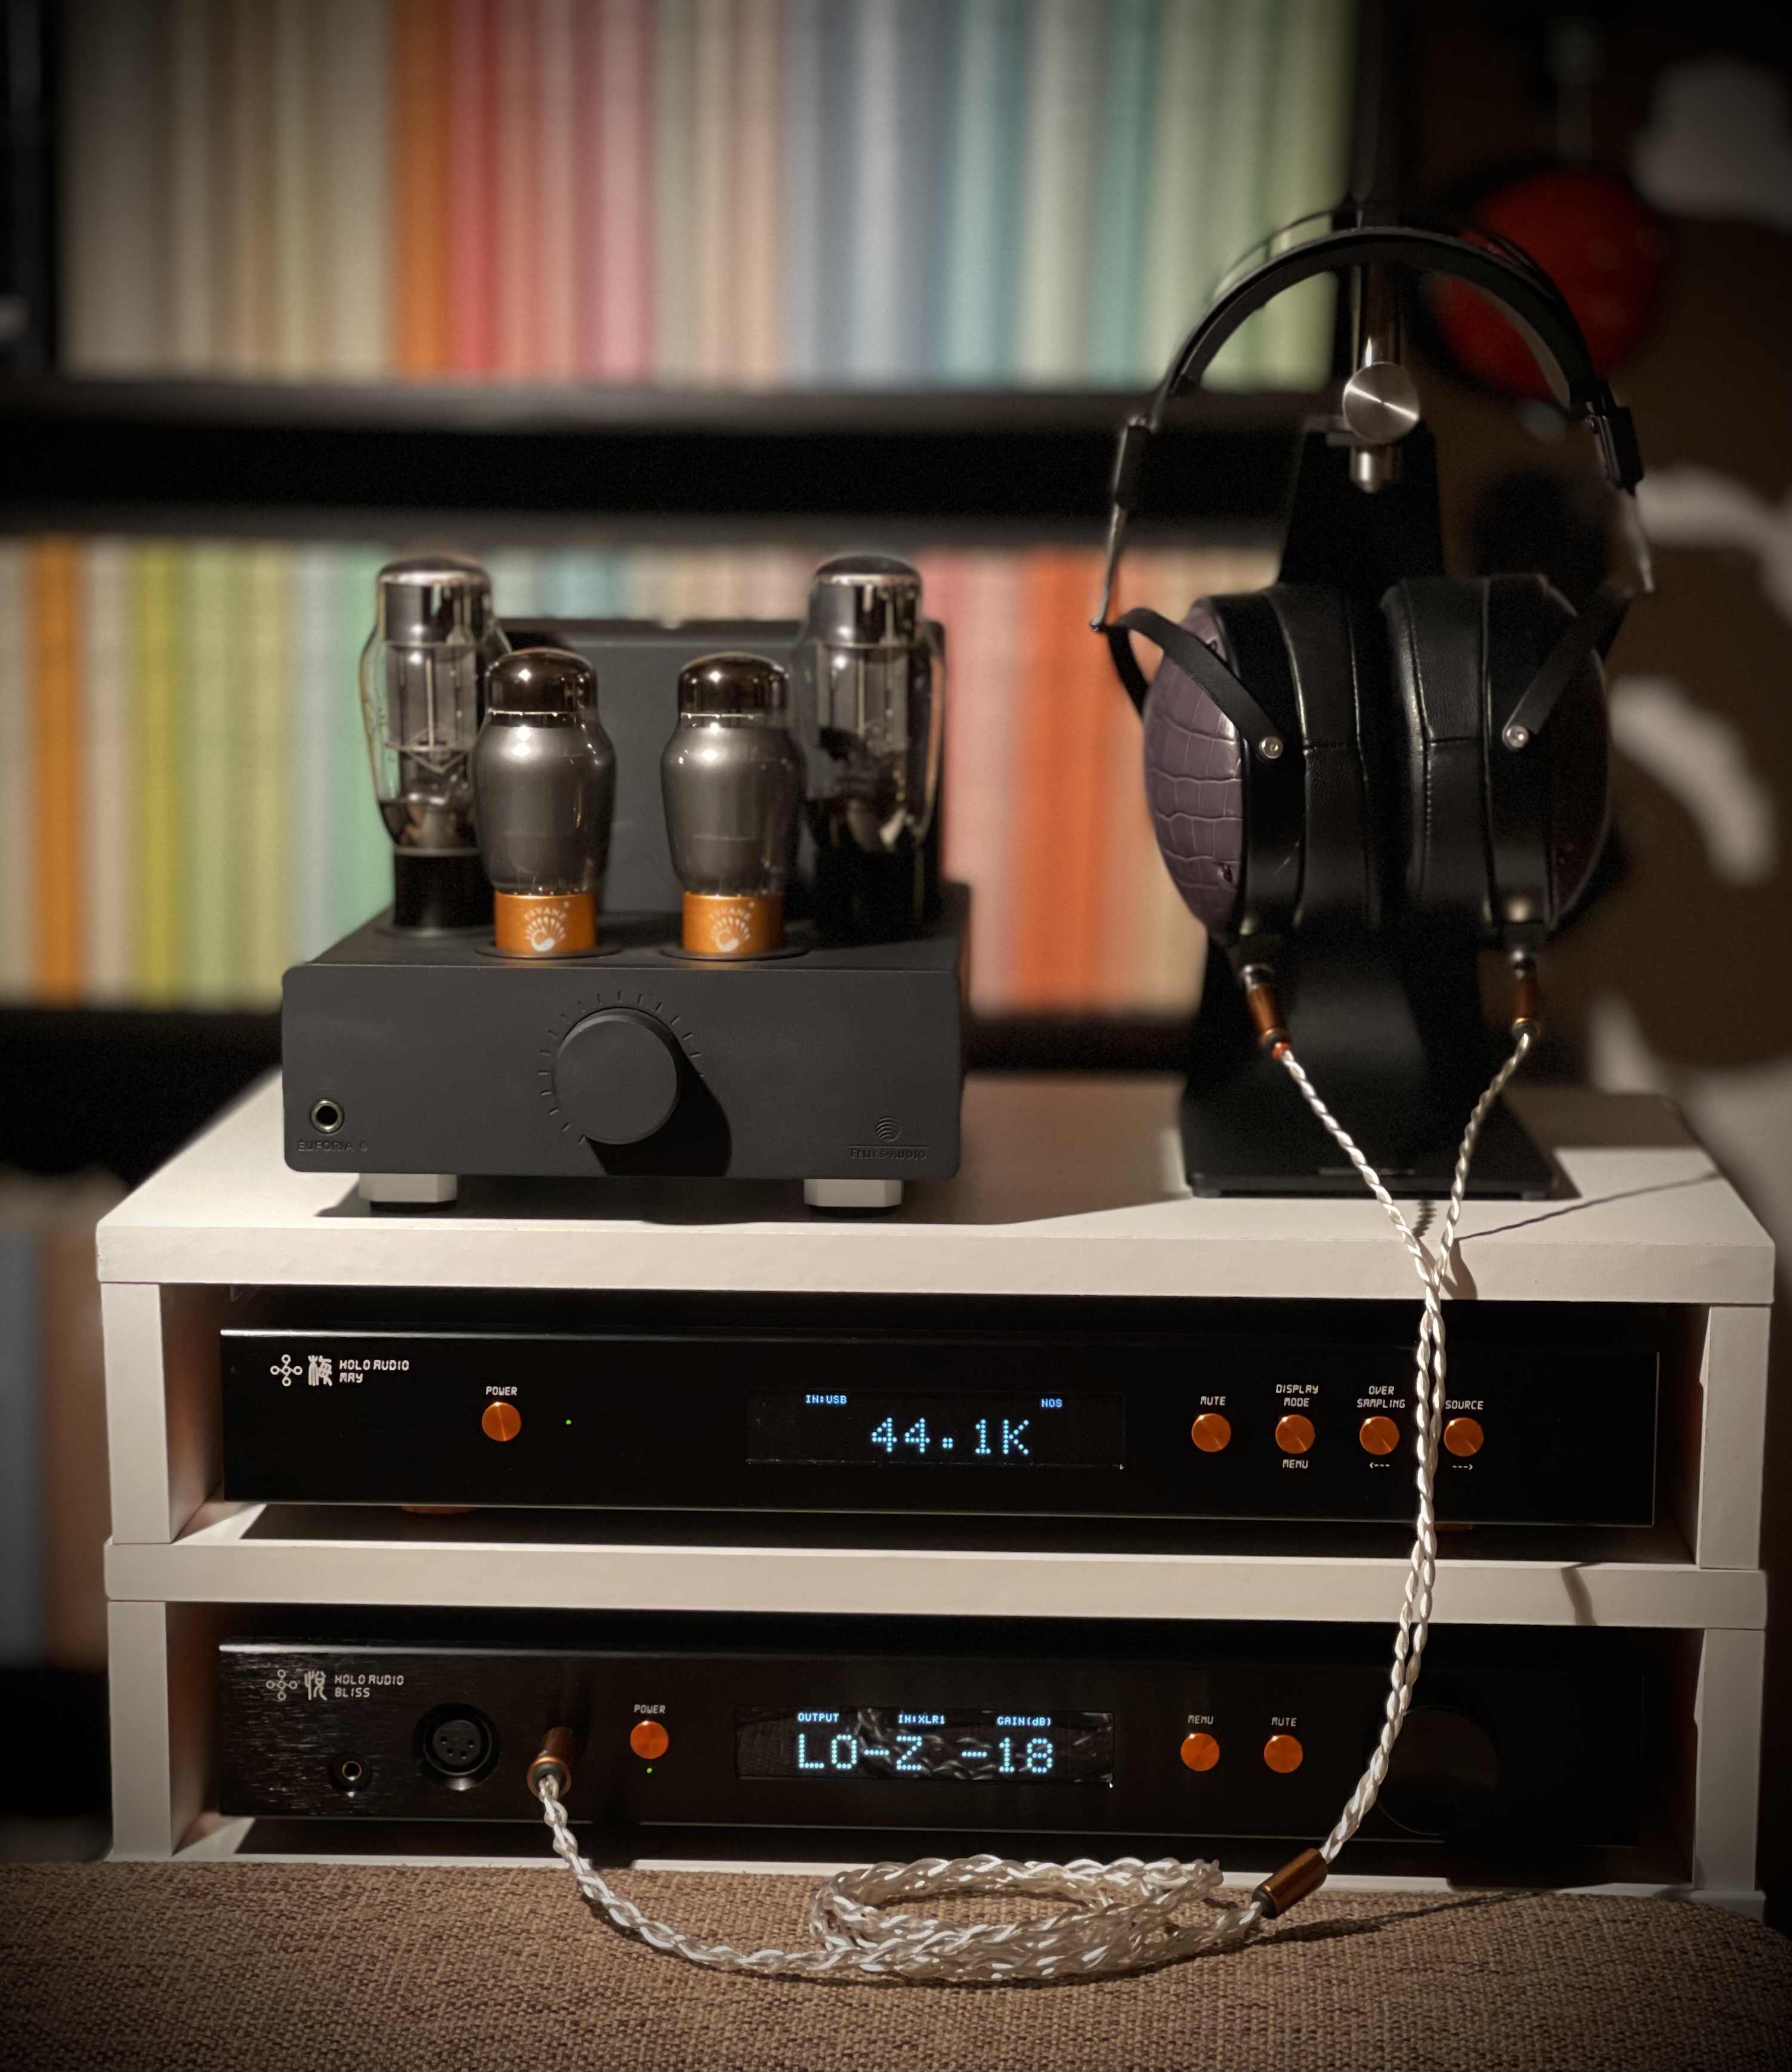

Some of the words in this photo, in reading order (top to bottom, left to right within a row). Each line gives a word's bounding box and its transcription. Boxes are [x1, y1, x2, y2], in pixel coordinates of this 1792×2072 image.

[298, 1141, 354, 1152] EUFORIA
[851, 1148, 927, 1160] FELIKS-AUDIO
[339, 1359, 371, 1370] HOLO
[373, 1359, 410, 1371] AUDIO
[339, 1372, 363, 1384] MAY
[485, 1386, 518, 1396] POWER
[1275, 1384, 1319, 1394] DISPLAY
[1368, 1385, 1395, 1395] OVER
[806, 1394, 848, 1404] IN:USB
[1041, 1398, 1063, 1408] NOS
[1200, 1396, 1226, 1406] MUTE
[1283, 1397, 1310, 1407] MODE
[1357, 1398, 1405, 1409] SAMPLING
[1445, 1400, 1484, 1410] SOURCE
[872, 1417, 1030, 1455] 44.1K
[1282, 1459, 1309, 1469] MENU
[334, 1674, 366, 1685] HOLO
[367, 1675, 404, 1685] AUDIO
[334, 1687, 370, 1698] BLISS
[634, 1704, 666, 1714] POWER
[797, 1712, 839, 1722] OUTPUT
[898, 1714, 946, 1725] IN:XLR1
[997, 1716, 1052, 1727] GAIN(dB)
[1188, 1715, 1214, 1725] MENU
[1271, 1716, 1297, 1727] MUTE
[798, 1733, 923, 1771] LO-Z
[961, 1737, 1053, 1773] -18
